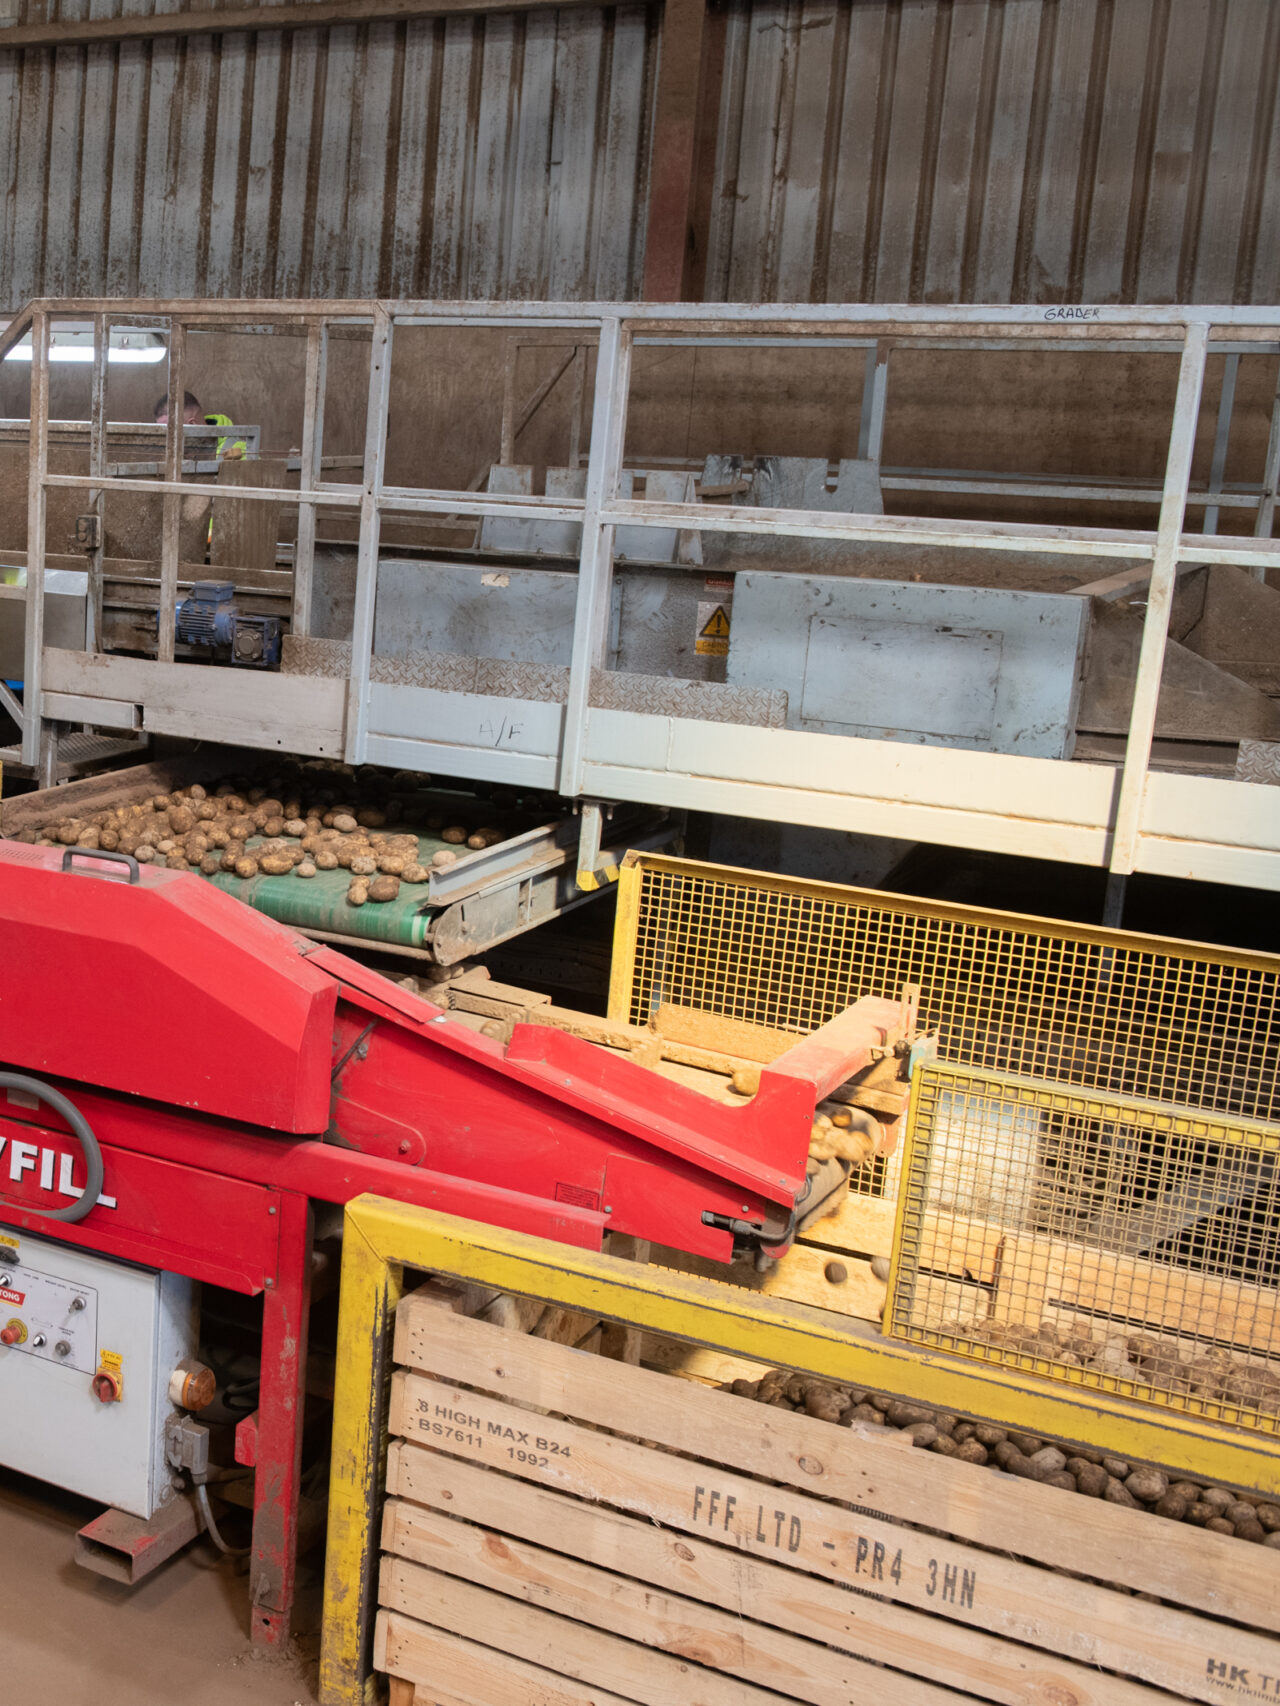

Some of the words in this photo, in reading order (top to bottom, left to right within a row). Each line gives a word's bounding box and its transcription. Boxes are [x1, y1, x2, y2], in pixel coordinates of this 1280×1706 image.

[1044, 307, 1100, 321] GRADER
[419, 1400, 429, 1413] 8
[435, 1405, 481, 1430] HIGH
[487, 1422, 529, 1446] MAX
[536, 1436, 572, 1459] B24
[419, 1418, 483, 1449] BS7611
[506, 1447, 549, 1470] 1992
[692, 1485, 737, 1531] FFF
[756, 1505, 802, 1553] LTD
[855, 1535, 903, 1586] PR4
[926, 1558, 977, 1609] 3HN
[1206, 1657, 1250, 1686] HK
